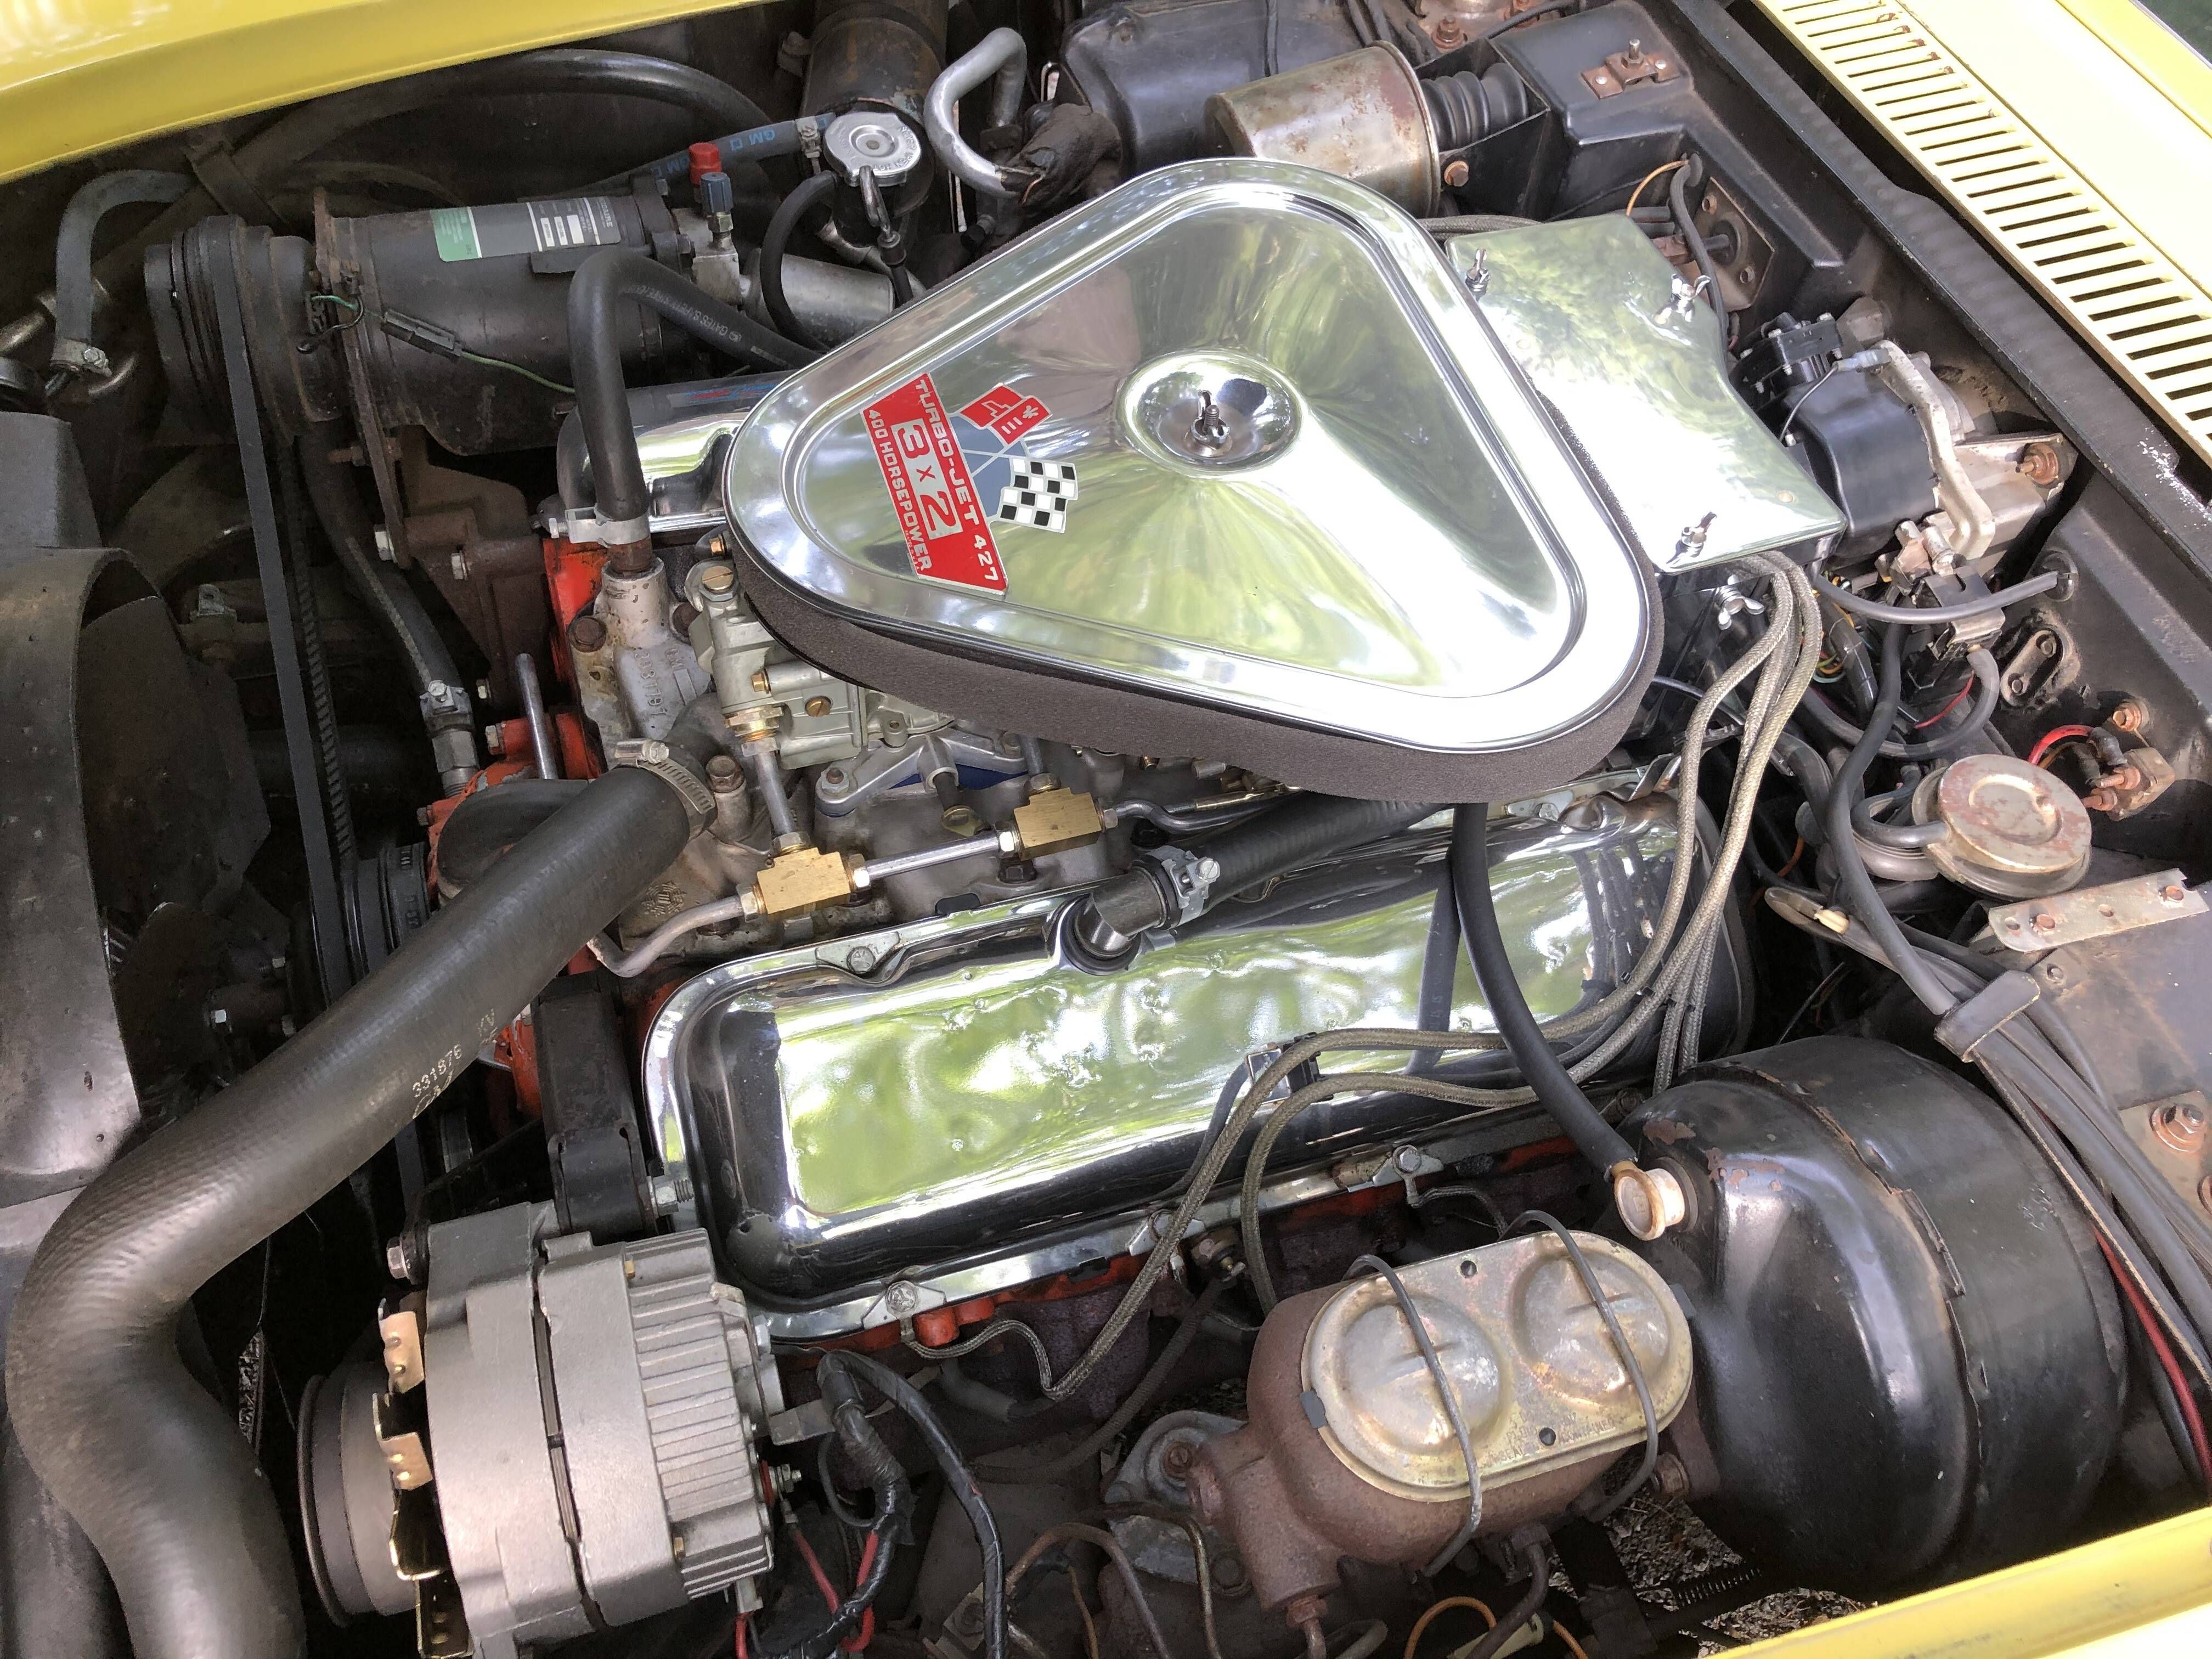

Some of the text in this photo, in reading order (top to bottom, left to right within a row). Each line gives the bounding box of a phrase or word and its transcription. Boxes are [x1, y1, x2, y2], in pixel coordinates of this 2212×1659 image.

[868, 409, 889, 439] 400
[880, 441, 933, 571] HORSEPOWER
[897, 424, 931, 459] 3
[919, 490, 957, 533] 2
[915, 379, 999, 582] TURBO-JET 427
